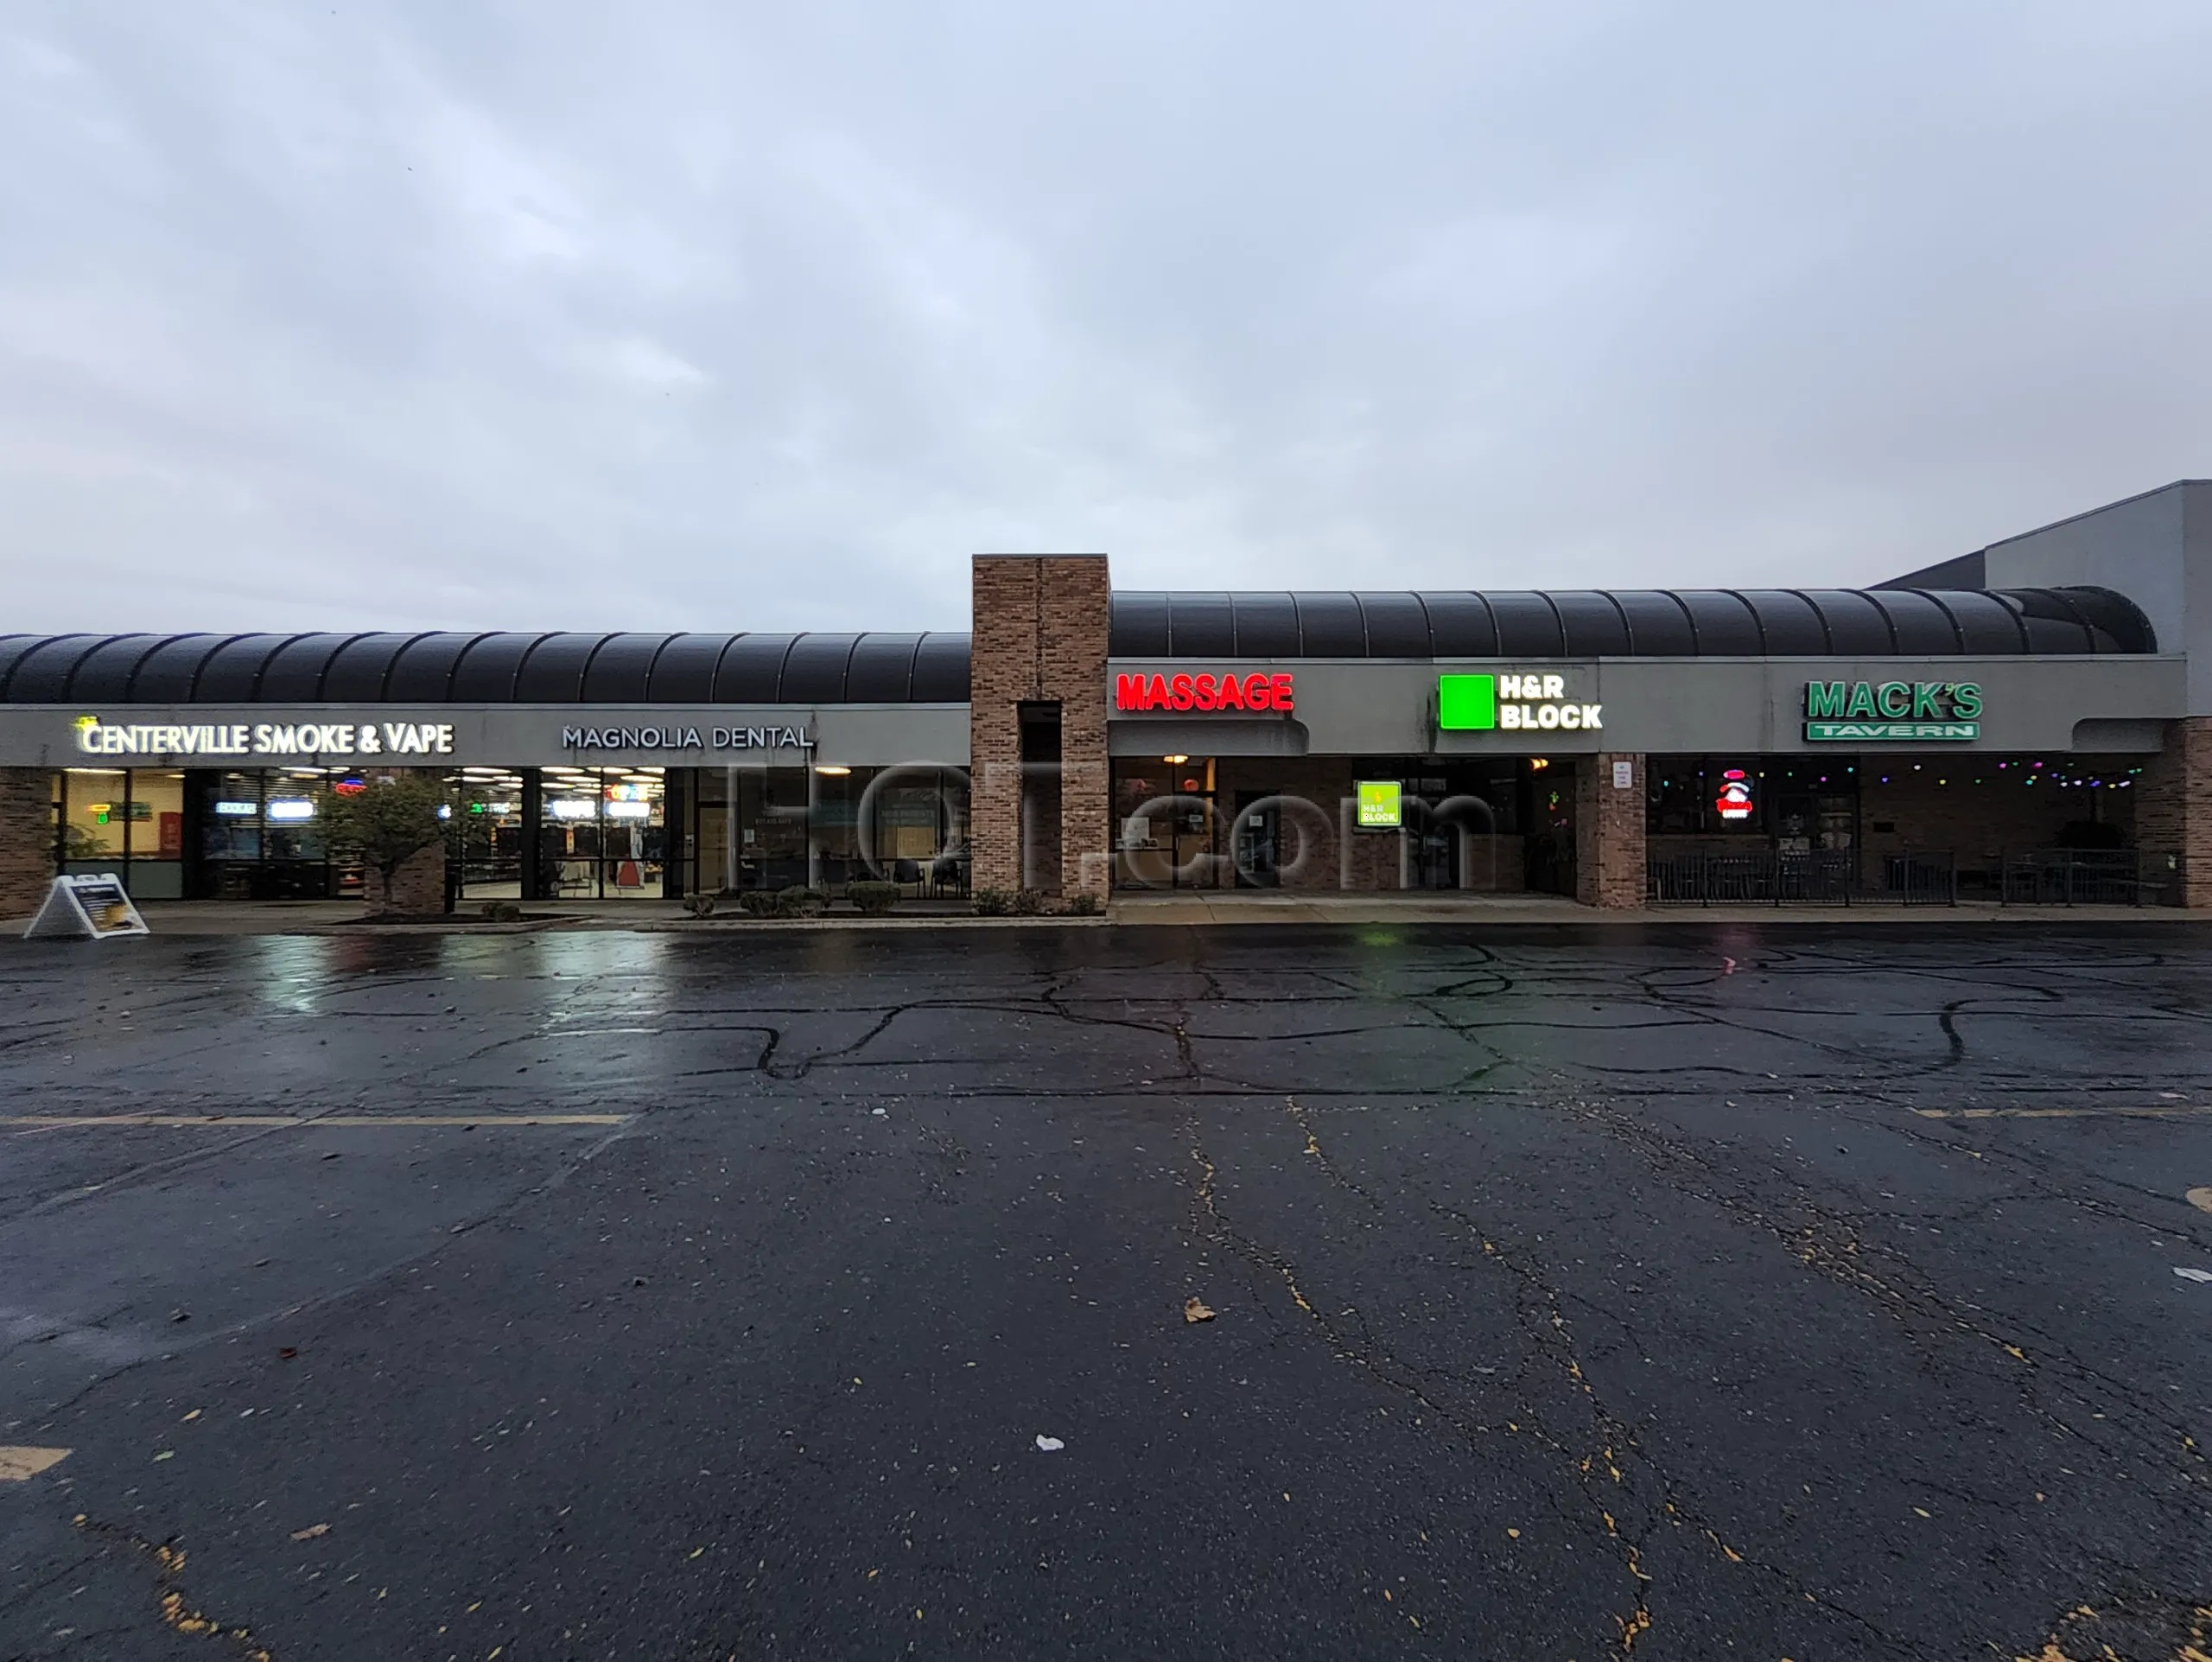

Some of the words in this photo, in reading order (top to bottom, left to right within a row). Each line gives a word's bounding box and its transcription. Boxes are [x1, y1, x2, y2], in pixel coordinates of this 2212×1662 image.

[1116, 672, 1294, 711] MASSAGE
[1499, 674, 1564, 699] H&R
[1808, 680, 1984, 719] MACK'S
[1499, 704, 1604, 729] BLOCK
[81, 723, 250, 755] CENTERVILLE
[252, 723, 354, 755] SMOKE
[359, 724, 382, 754] &
[384, 723, 454, 755] VAPE
[562, 725, 703, 748] MAGNOLIA
[712, 727, 814, 748] DENTAL
[1814, 724, 1974, 736] TAVERN
[1362, 812, 1397, 822] BLOCK
